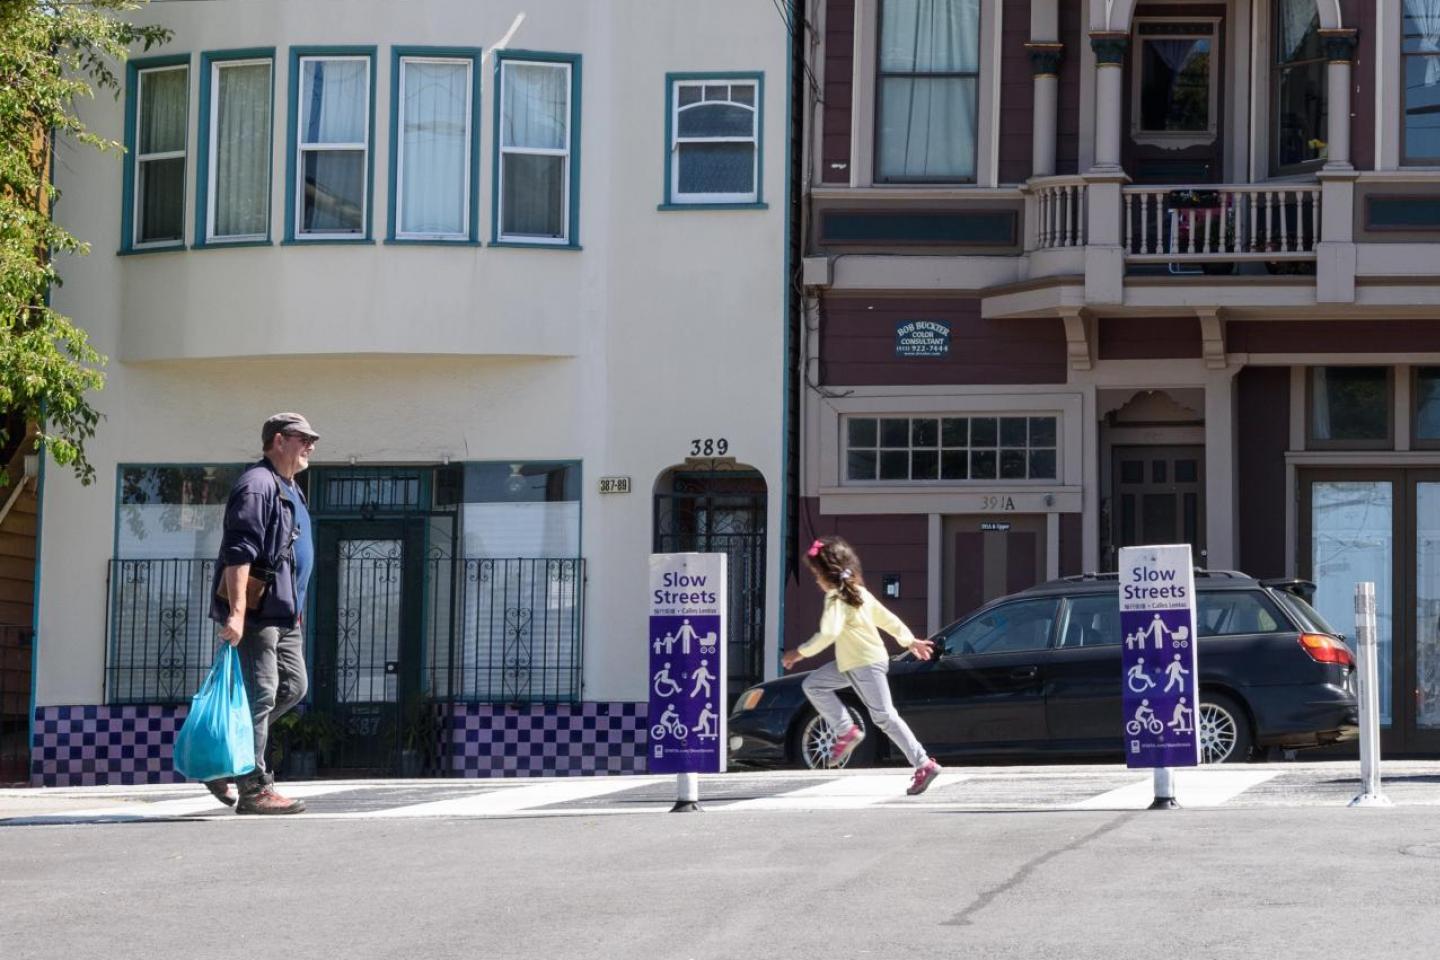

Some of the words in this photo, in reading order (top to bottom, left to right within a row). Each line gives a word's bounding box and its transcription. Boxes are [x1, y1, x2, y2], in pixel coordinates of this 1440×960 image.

[897, 323, 915, 337] BOB
[690, 438, 729, 456] 389
[600, 479, 627, 492] 387-89
[981, 496, 1015, 510] 391A
[663, 571, 706, 587] Slow
[1132, 566, 1176, 582] Slow
[654, 589, 716, 604] Streets
[1124, 585, 1185, 600] Streets
